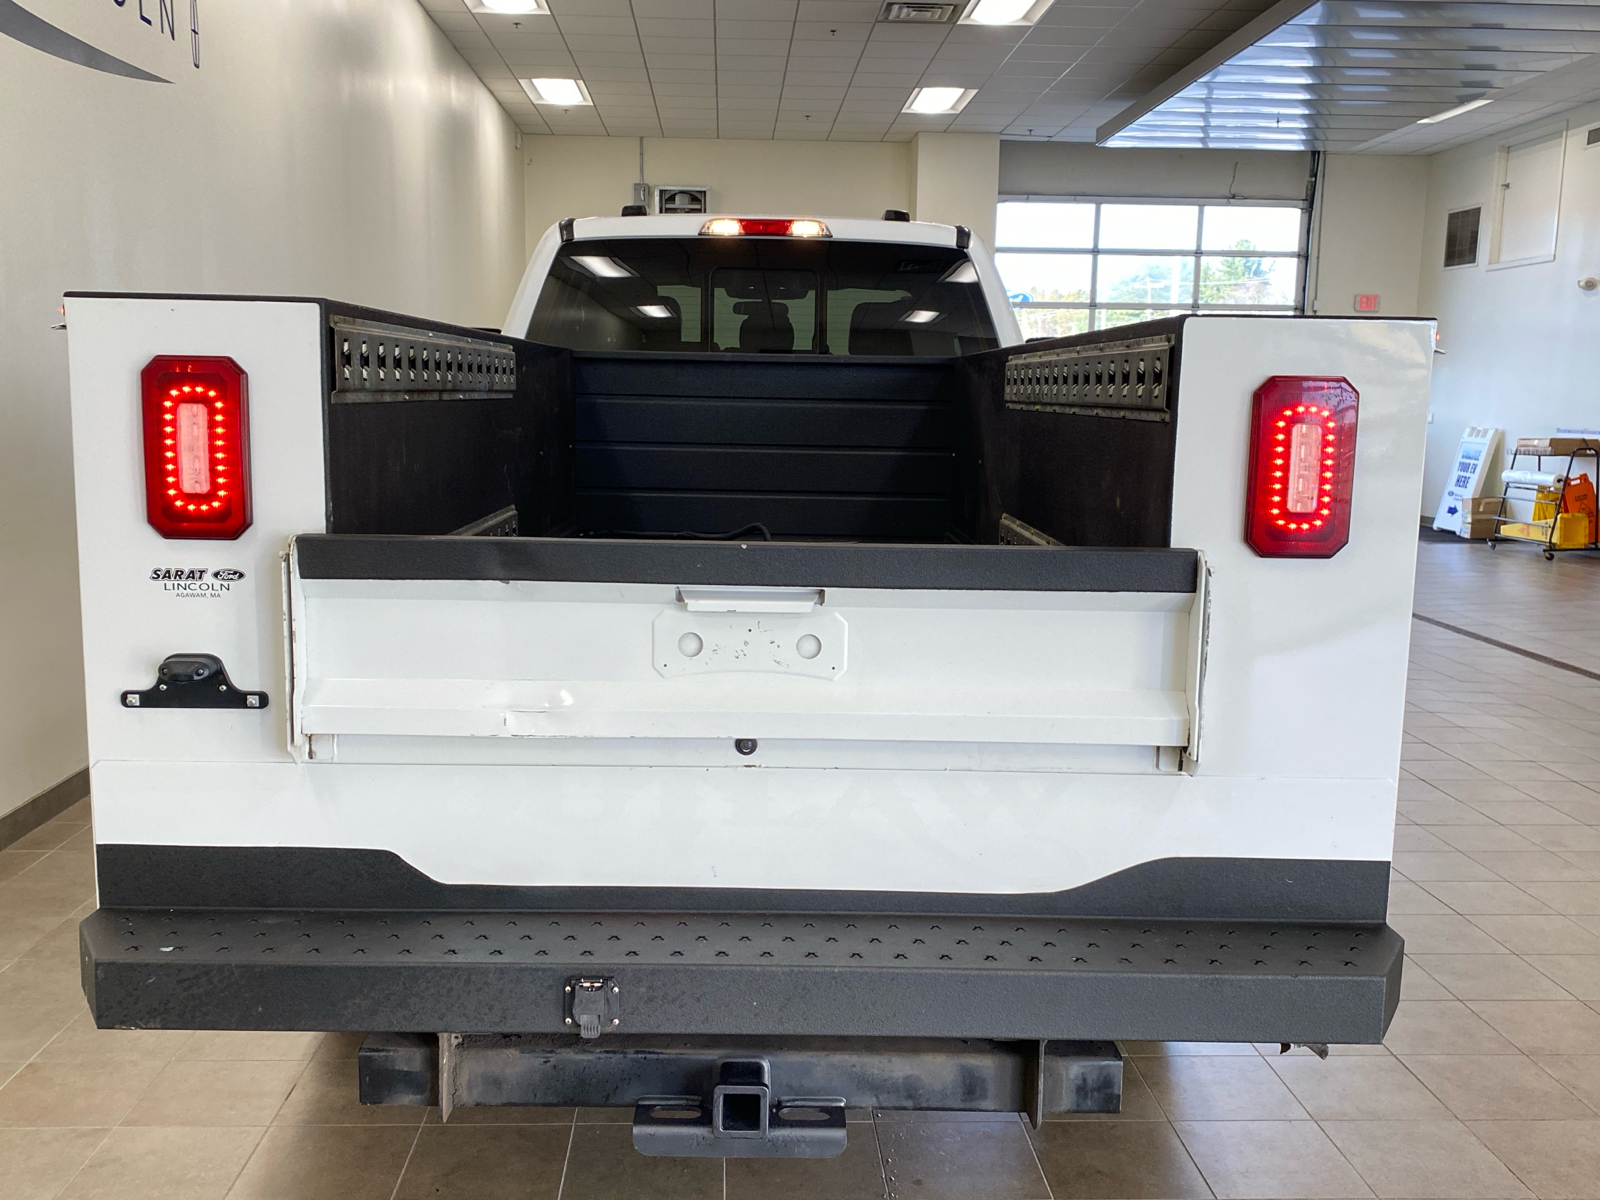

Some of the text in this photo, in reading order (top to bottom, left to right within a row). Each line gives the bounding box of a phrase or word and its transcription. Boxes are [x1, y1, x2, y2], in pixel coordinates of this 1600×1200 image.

[1359, 294, 1378, 310] EXIT
[1454, 474, 1471, 489] HERE
[150, 567, 242, 581] SARAT Ford
[164, 582, 230, 591] LINCOLN
